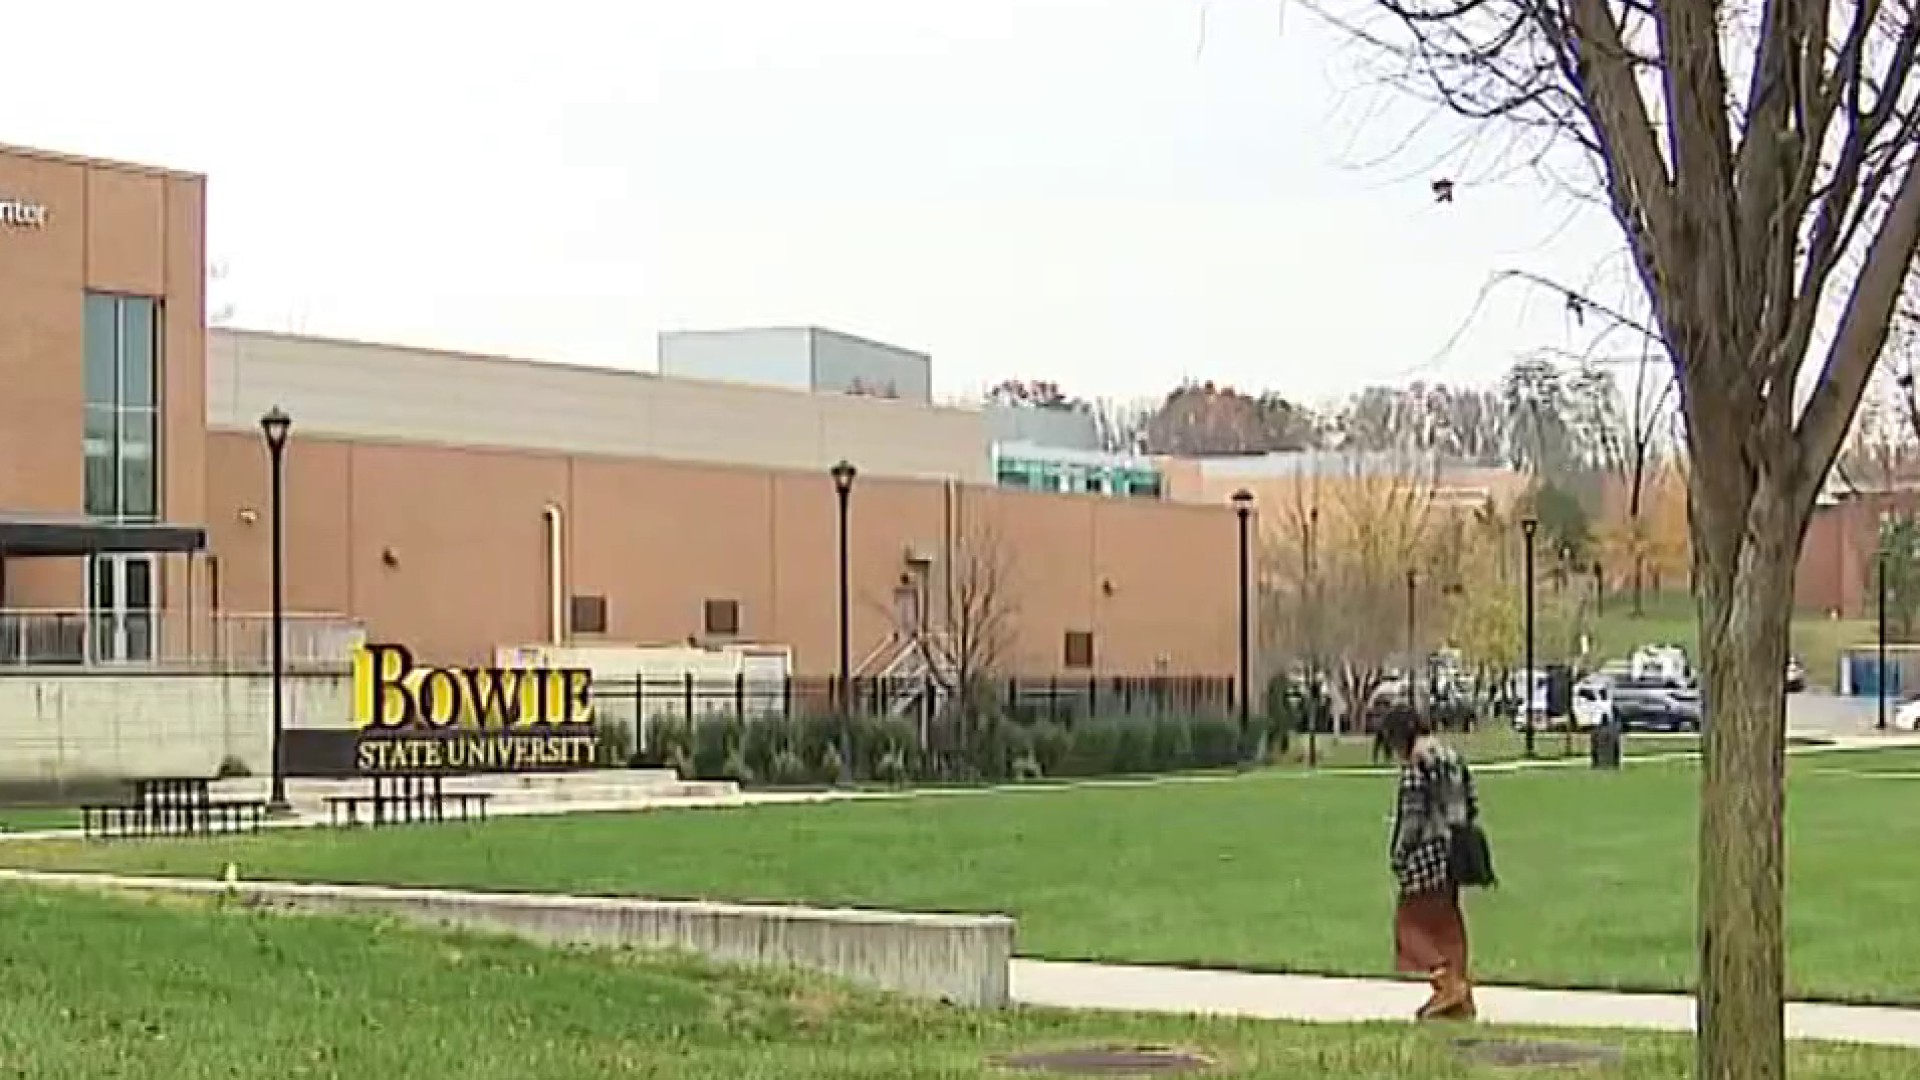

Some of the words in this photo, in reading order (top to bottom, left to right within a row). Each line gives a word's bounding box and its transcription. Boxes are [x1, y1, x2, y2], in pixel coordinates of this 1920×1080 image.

[358, 643, 593, 730] BOWIE
[358, 740, 442, 770] STATE
[449, 736, 597, 768] UNIVERSITY
